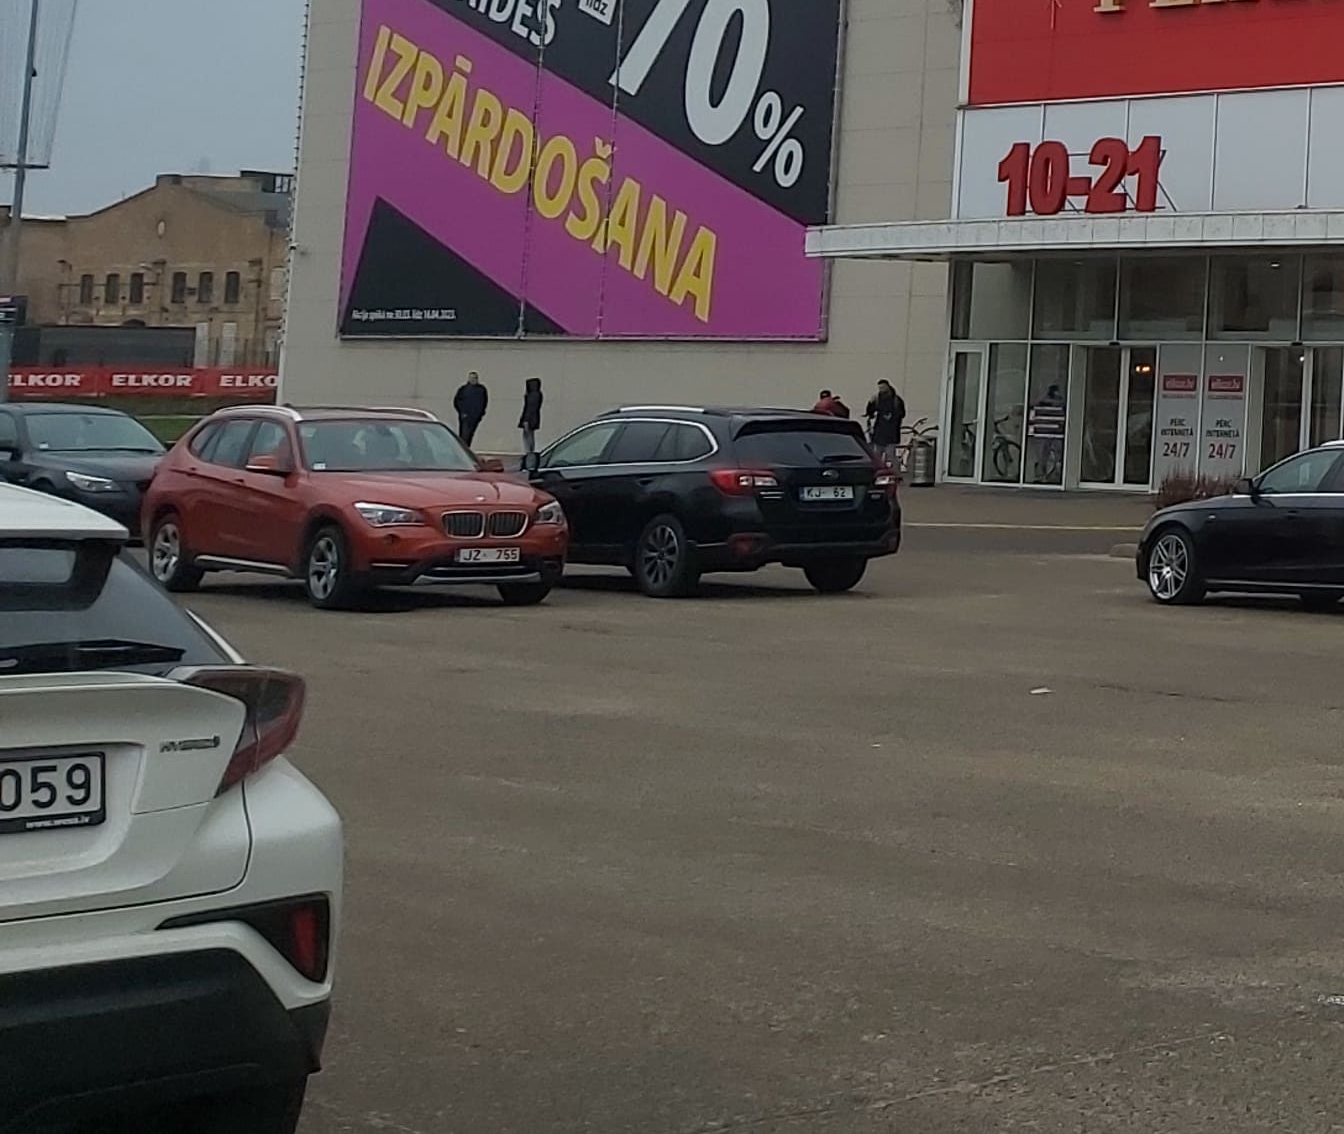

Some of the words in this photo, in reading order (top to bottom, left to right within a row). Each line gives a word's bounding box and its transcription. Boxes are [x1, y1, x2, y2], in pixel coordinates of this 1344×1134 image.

[363, 25, 717, 322] IZPĀRDOŠANA
[998, 136, 1162, 216] 10-21
[112, 374, 193, 386] ELKOR
[219, 375, 279, 386] ELKO
[1163, 442, 1190, 458] 24/7
[1208, 443, 1237, 459] 24/7
